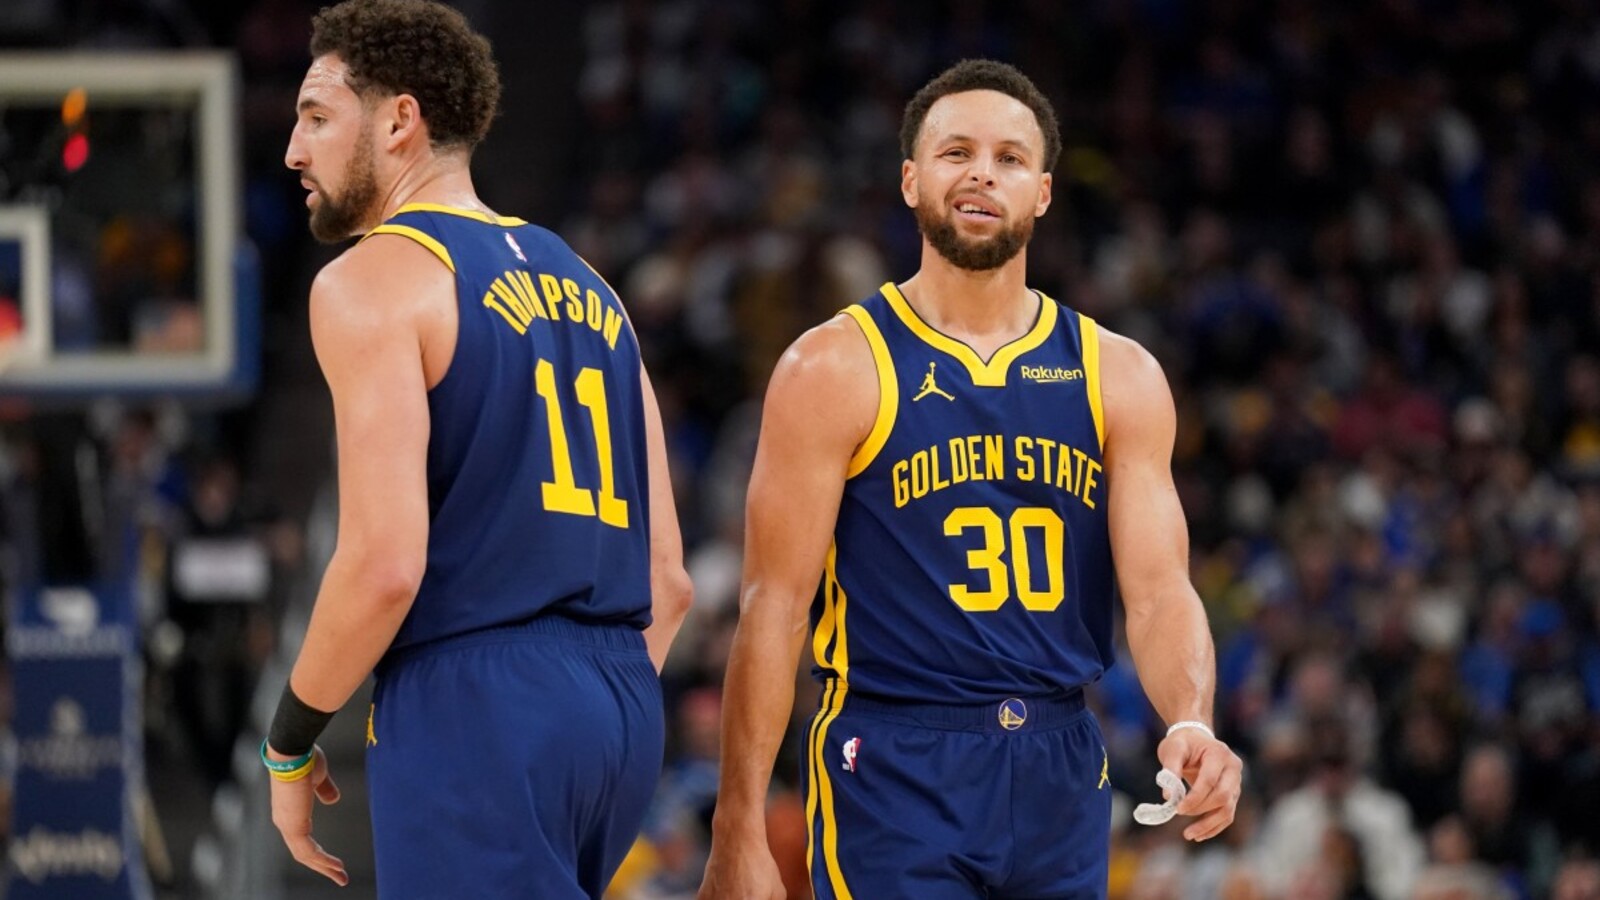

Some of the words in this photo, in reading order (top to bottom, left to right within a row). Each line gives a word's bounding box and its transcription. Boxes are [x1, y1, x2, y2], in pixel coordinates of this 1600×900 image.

[482, 269, 624, 351] THOMPSON
[1020, 365, 1083, 382] Rakuten
[535, 357, 629, 529] 11
[892, 434, 1005, 509] GOLDEN
[1014, 435, 1103, 510] STATE
[943, 506, 1065, 612] 30
